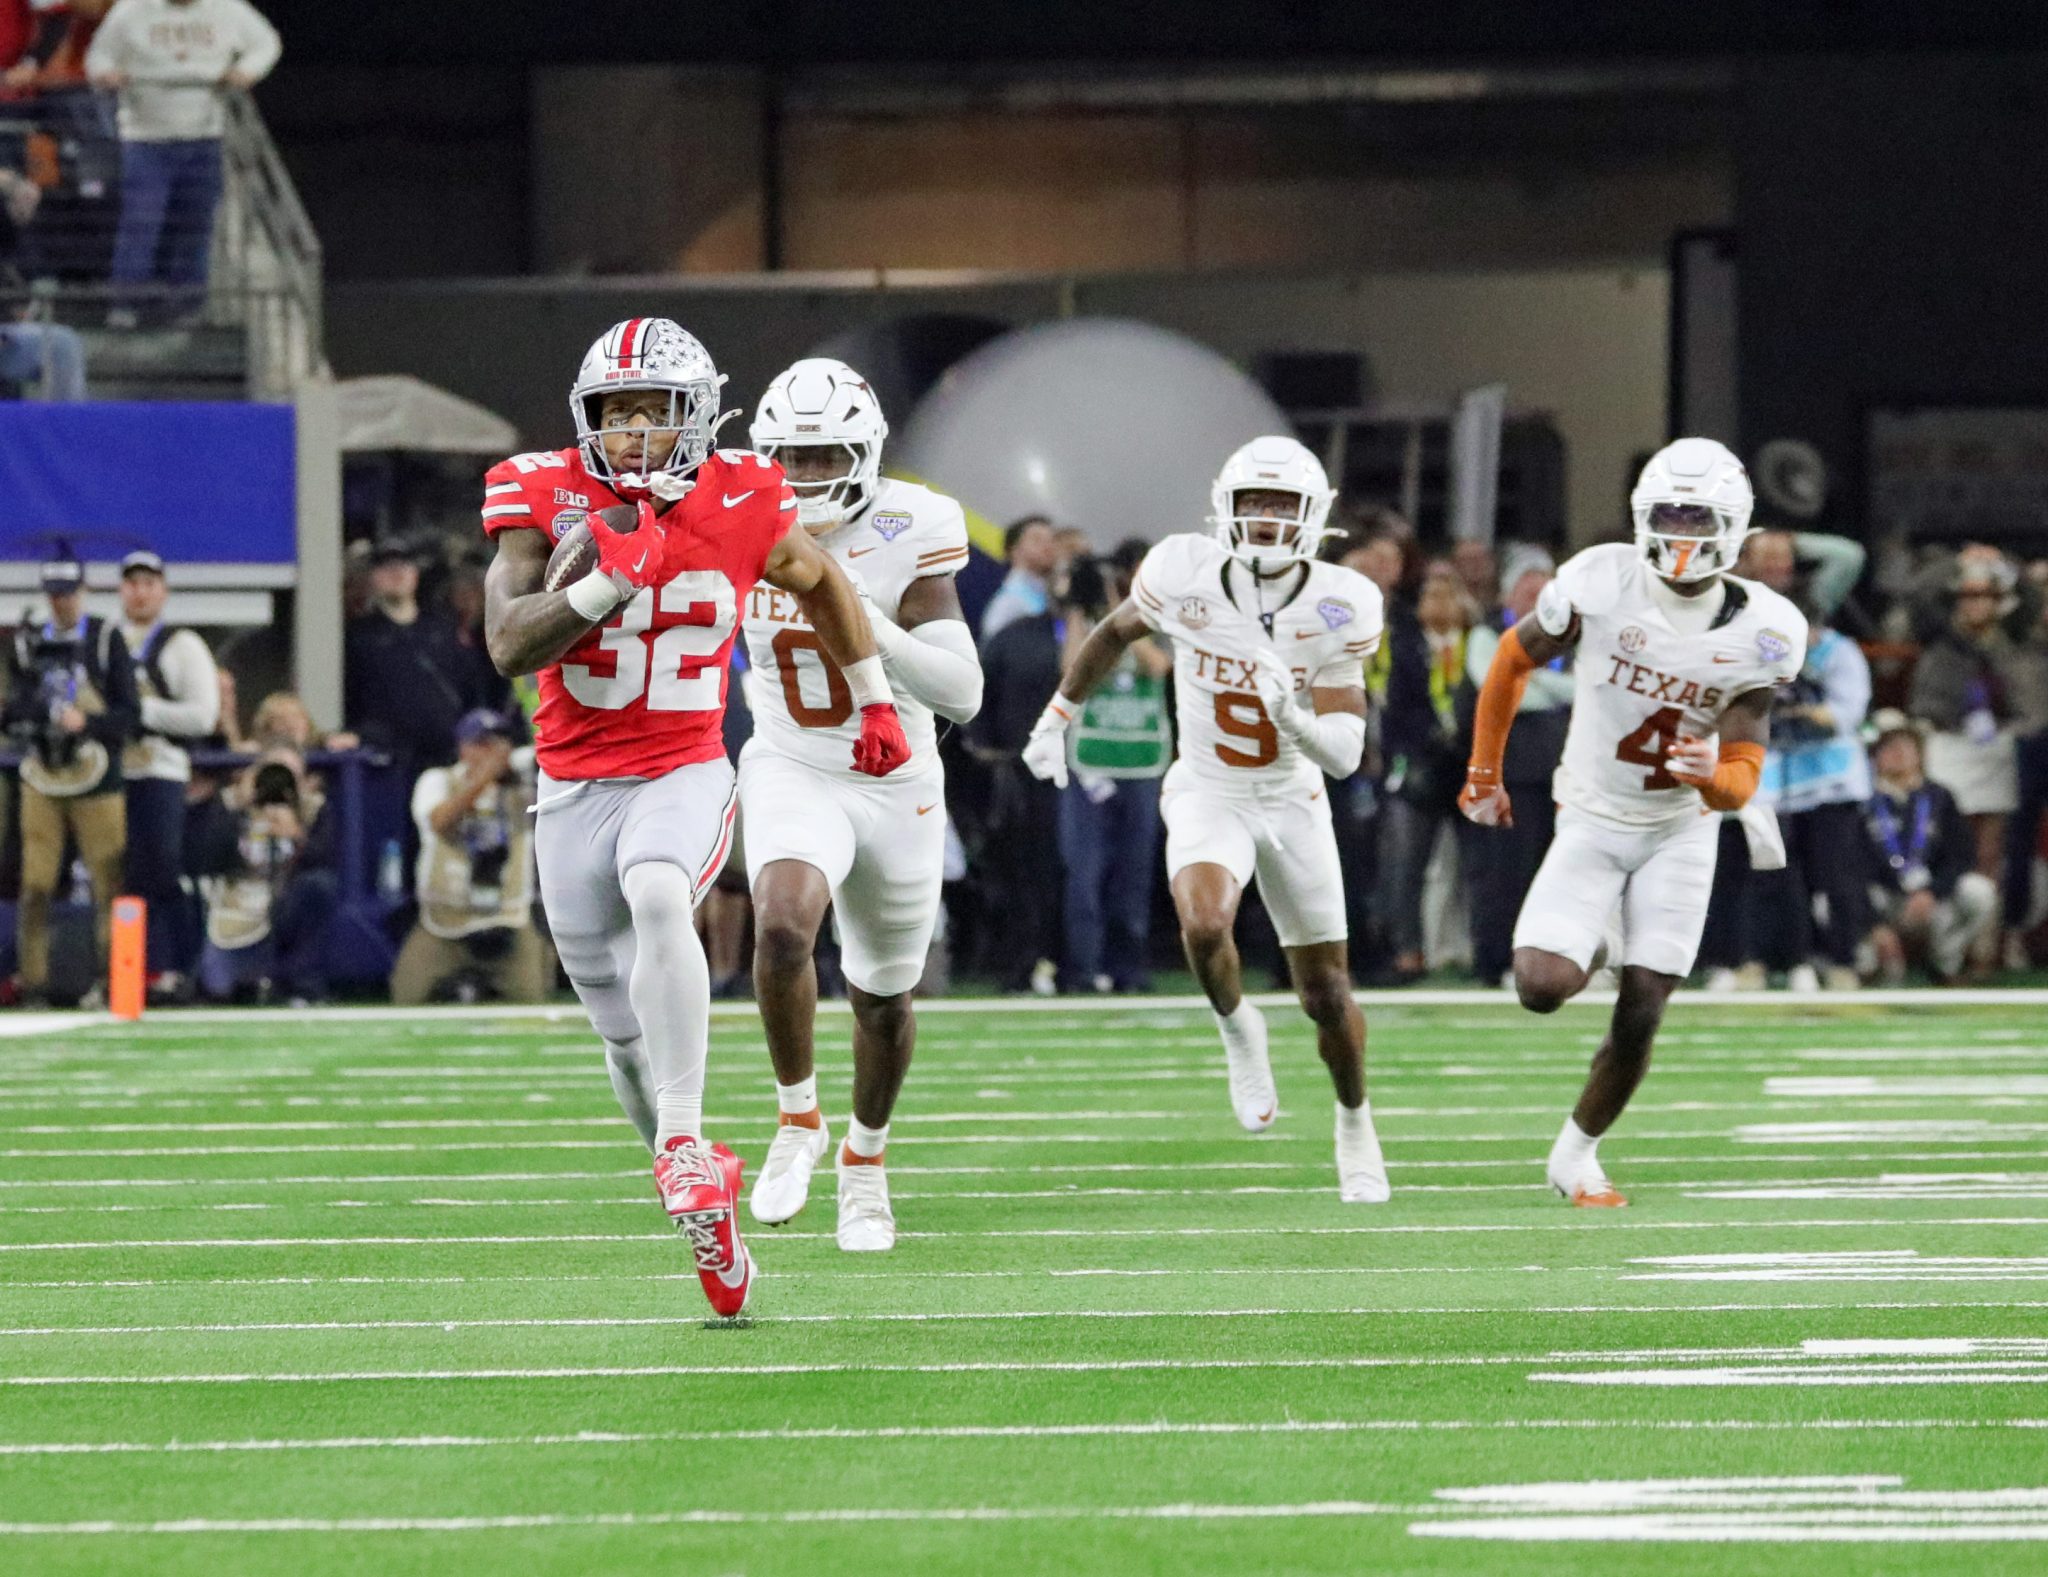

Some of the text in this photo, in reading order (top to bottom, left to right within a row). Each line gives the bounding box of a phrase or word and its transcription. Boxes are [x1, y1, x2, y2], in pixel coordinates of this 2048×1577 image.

[561, 569, 737, 711] 32
[750, 585, 813, 625] TEX
[771, 628, 855, 728] 0
[1194, 648, 1307, 692] TEXS
[1608, 654, 1723, 708] TEXAS
[1213, 690, 1280, 768] 9
[1615, 706, 1684, 791] 4
